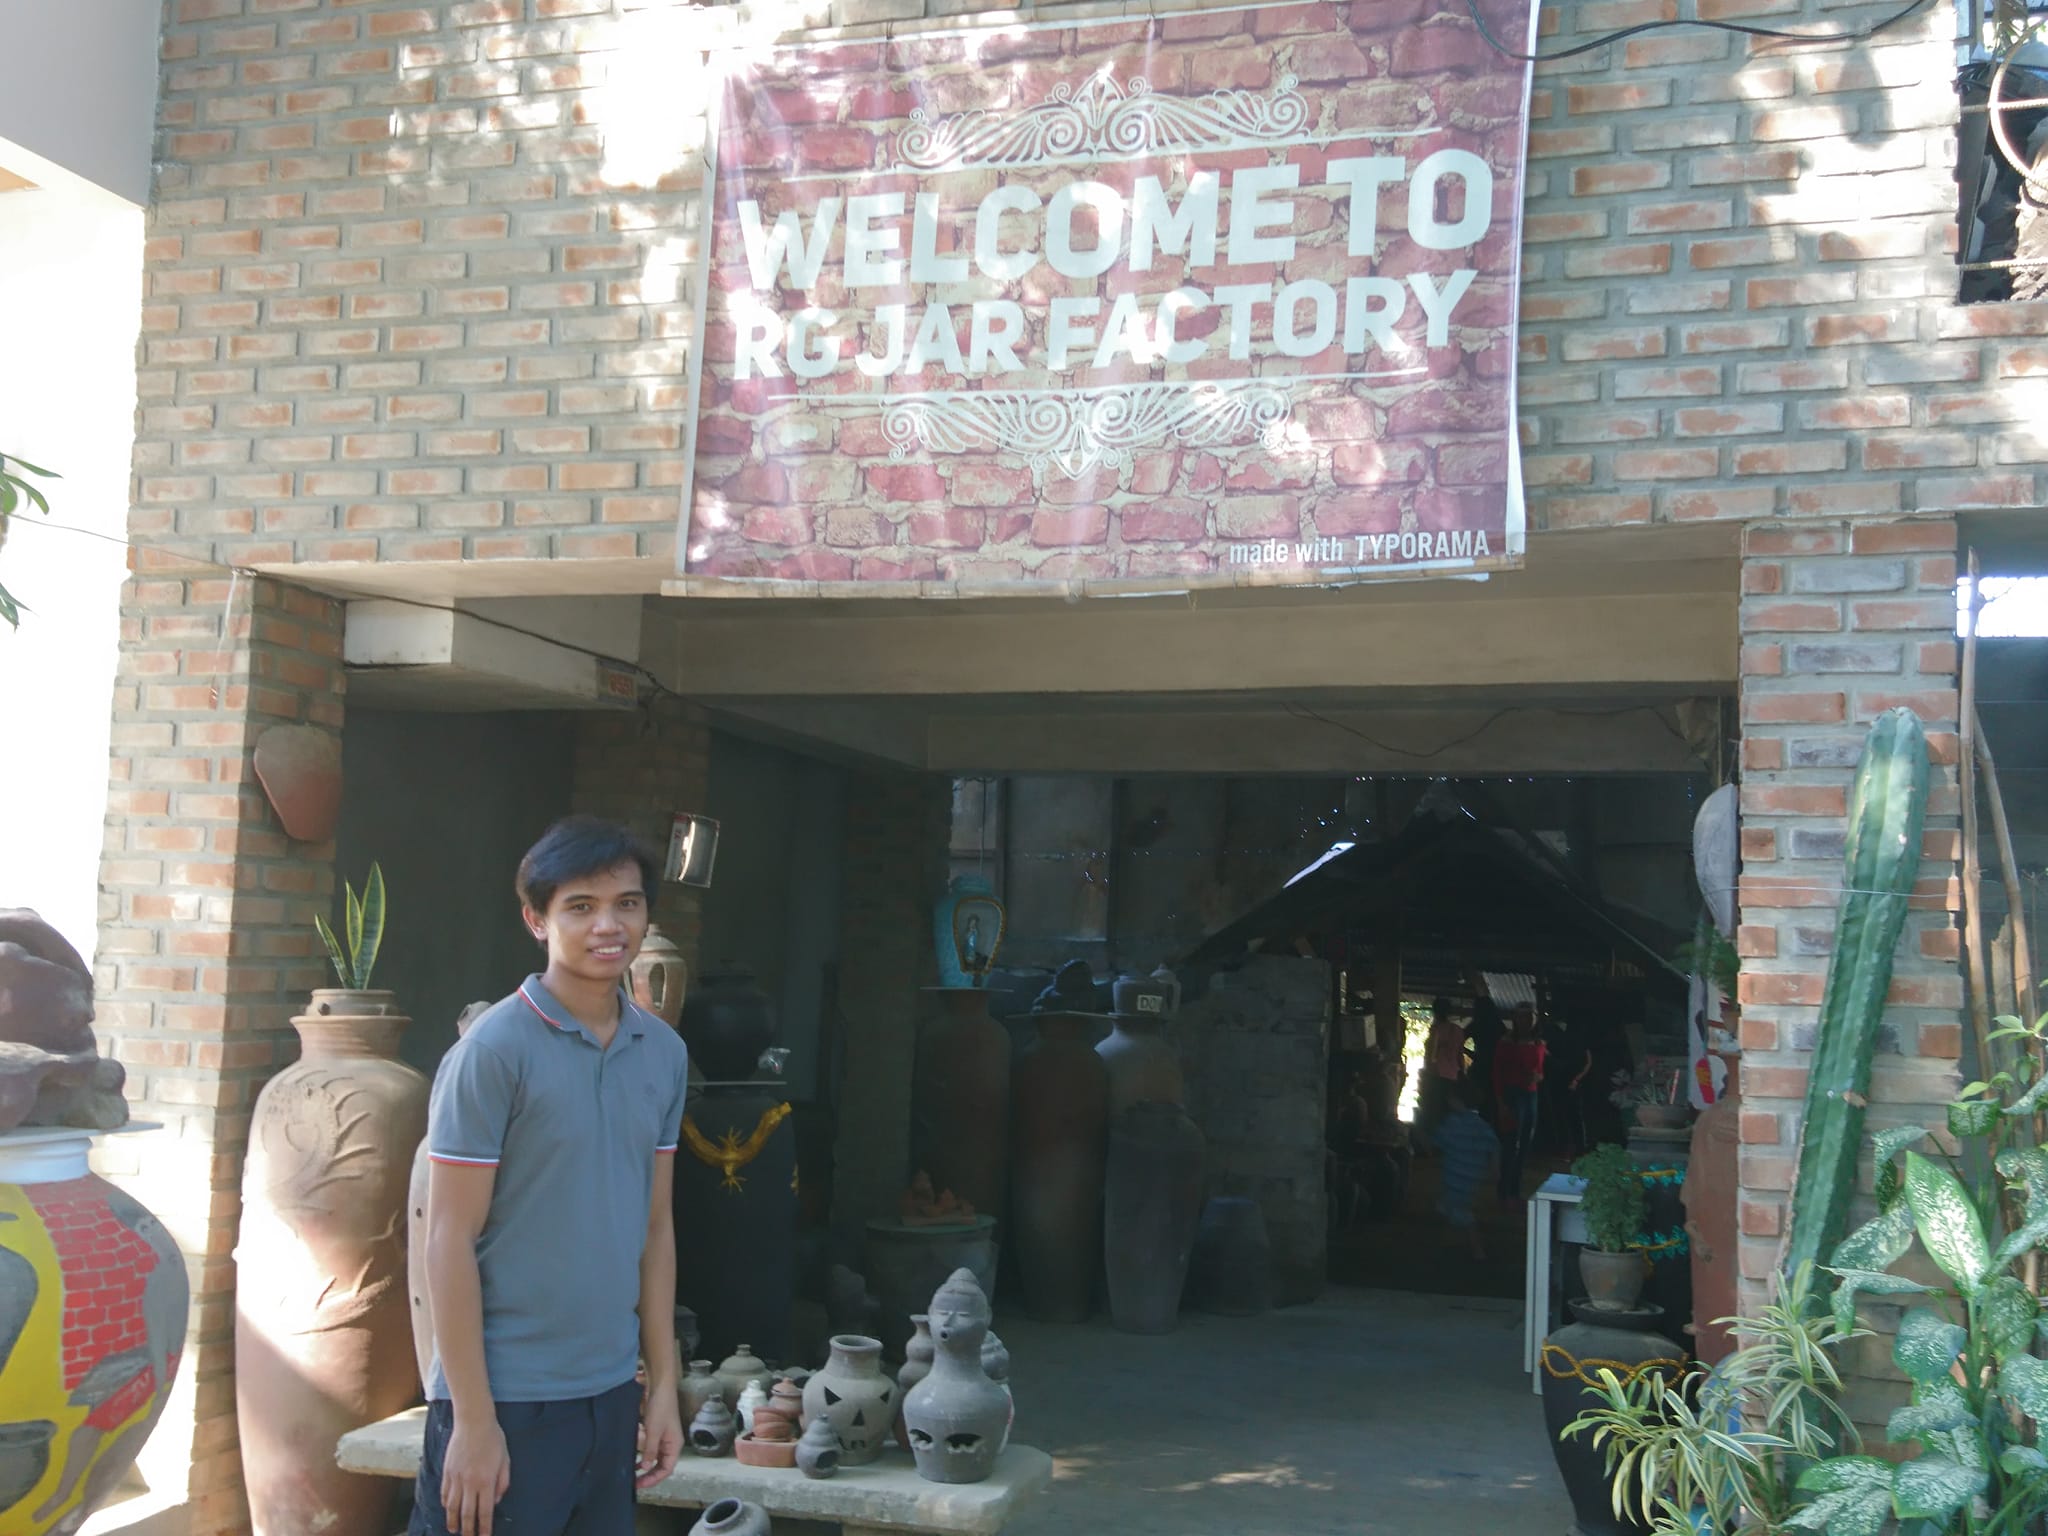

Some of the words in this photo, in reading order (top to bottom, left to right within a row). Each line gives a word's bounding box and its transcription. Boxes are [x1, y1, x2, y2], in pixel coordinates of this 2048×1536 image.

[737, 163, 1300, 291] WELCOME
[1326, 148, 1493, 257] TO
[733, 302, 841, 380] RG
[855, 299, 1025, 377] JAR
[1047, 269, 1478, 371] FACTORY
[1229, 537, 1288, 564] made
[1295, 536, 1344, 563] with
[1354, 530, 1490, 561] TYPORAMA
